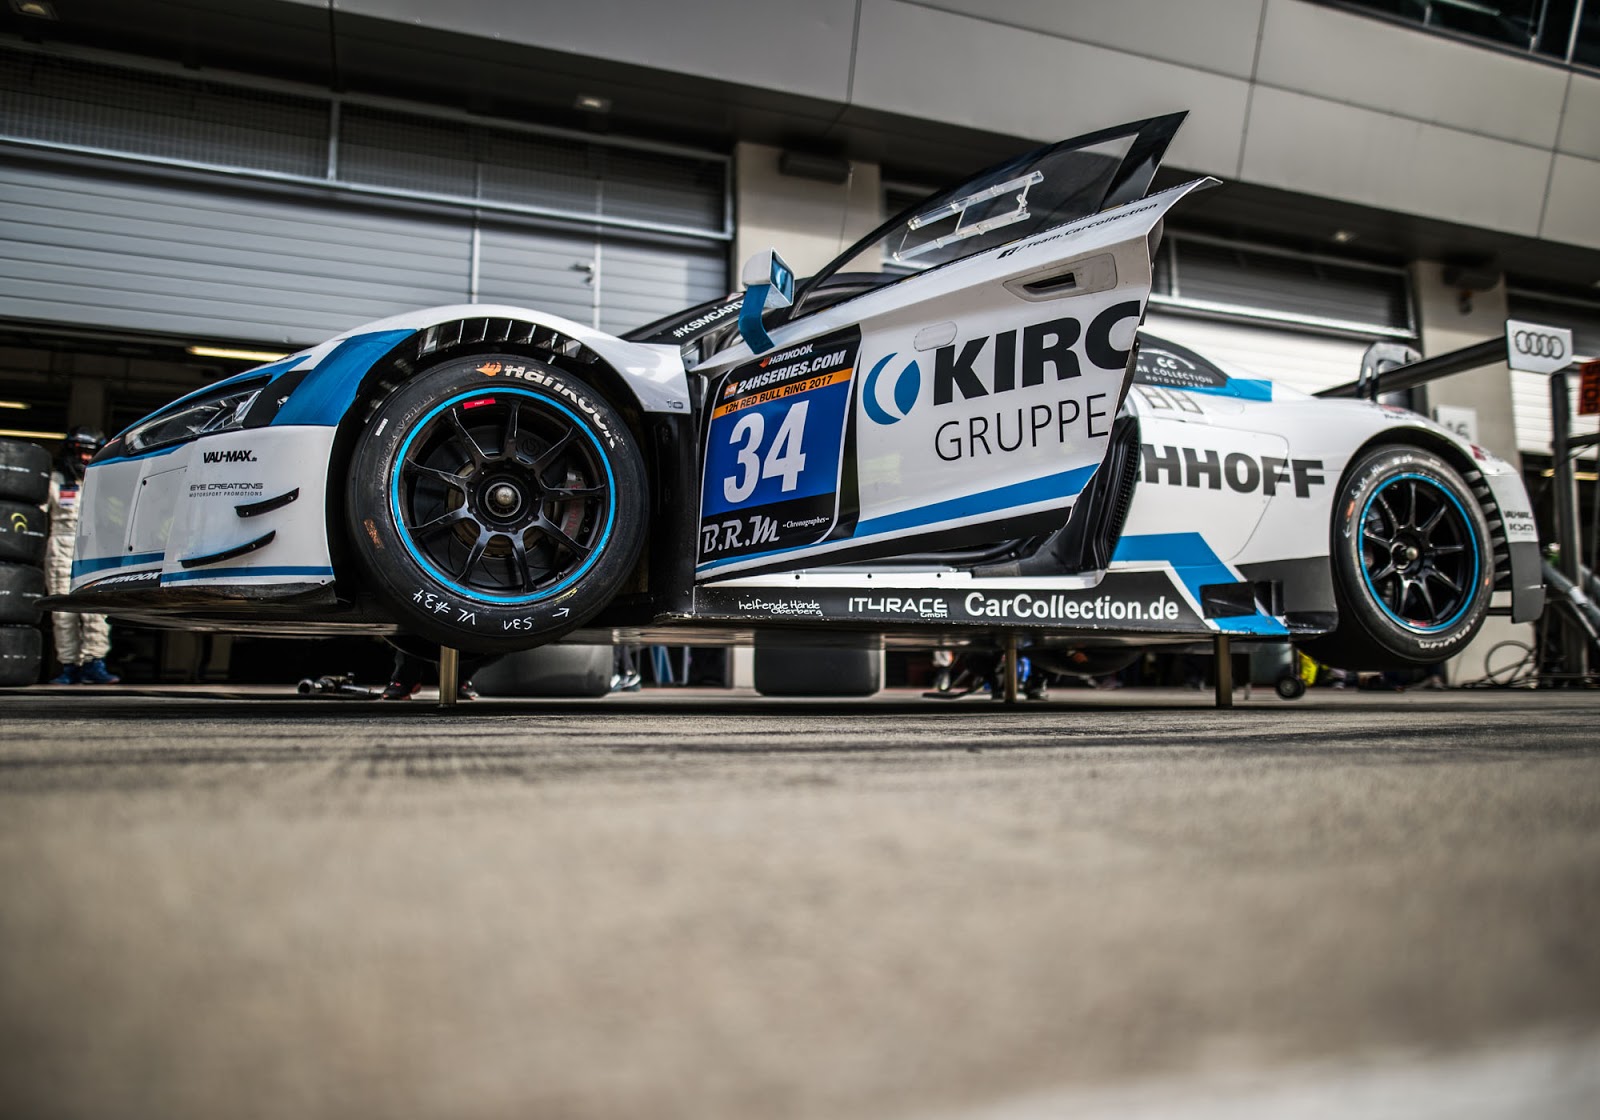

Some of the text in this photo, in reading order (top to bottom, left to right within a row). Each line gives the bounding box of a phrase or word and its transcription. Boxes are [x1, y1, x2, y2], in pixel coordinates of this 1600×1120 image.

[933, 300, 1141, 406] KIRC
[737, 350, 847, 394] 24HSERIES.COM
[1152, 367, 1214, 384] COLLECTION
[725, 402, 739, 414] 12H
[740, 395, 757, 408] RED
[760, 390, 782, 403] BULL
[784, 382, 807, 397] RING
[810, 375, 834, 389] 2017
[934, 393, 1109, 462] GRUPPE
[723, 400, 810, 503] 34
[189, 482, 264, 491] EYE CREATIONS
[412, 589, 451, 614] #34
[738, 599, 821, 610] helfende Hände
[770, 608, 824, 617] Oberberg
[964, 592, 1179, 620] CarCollection.de
